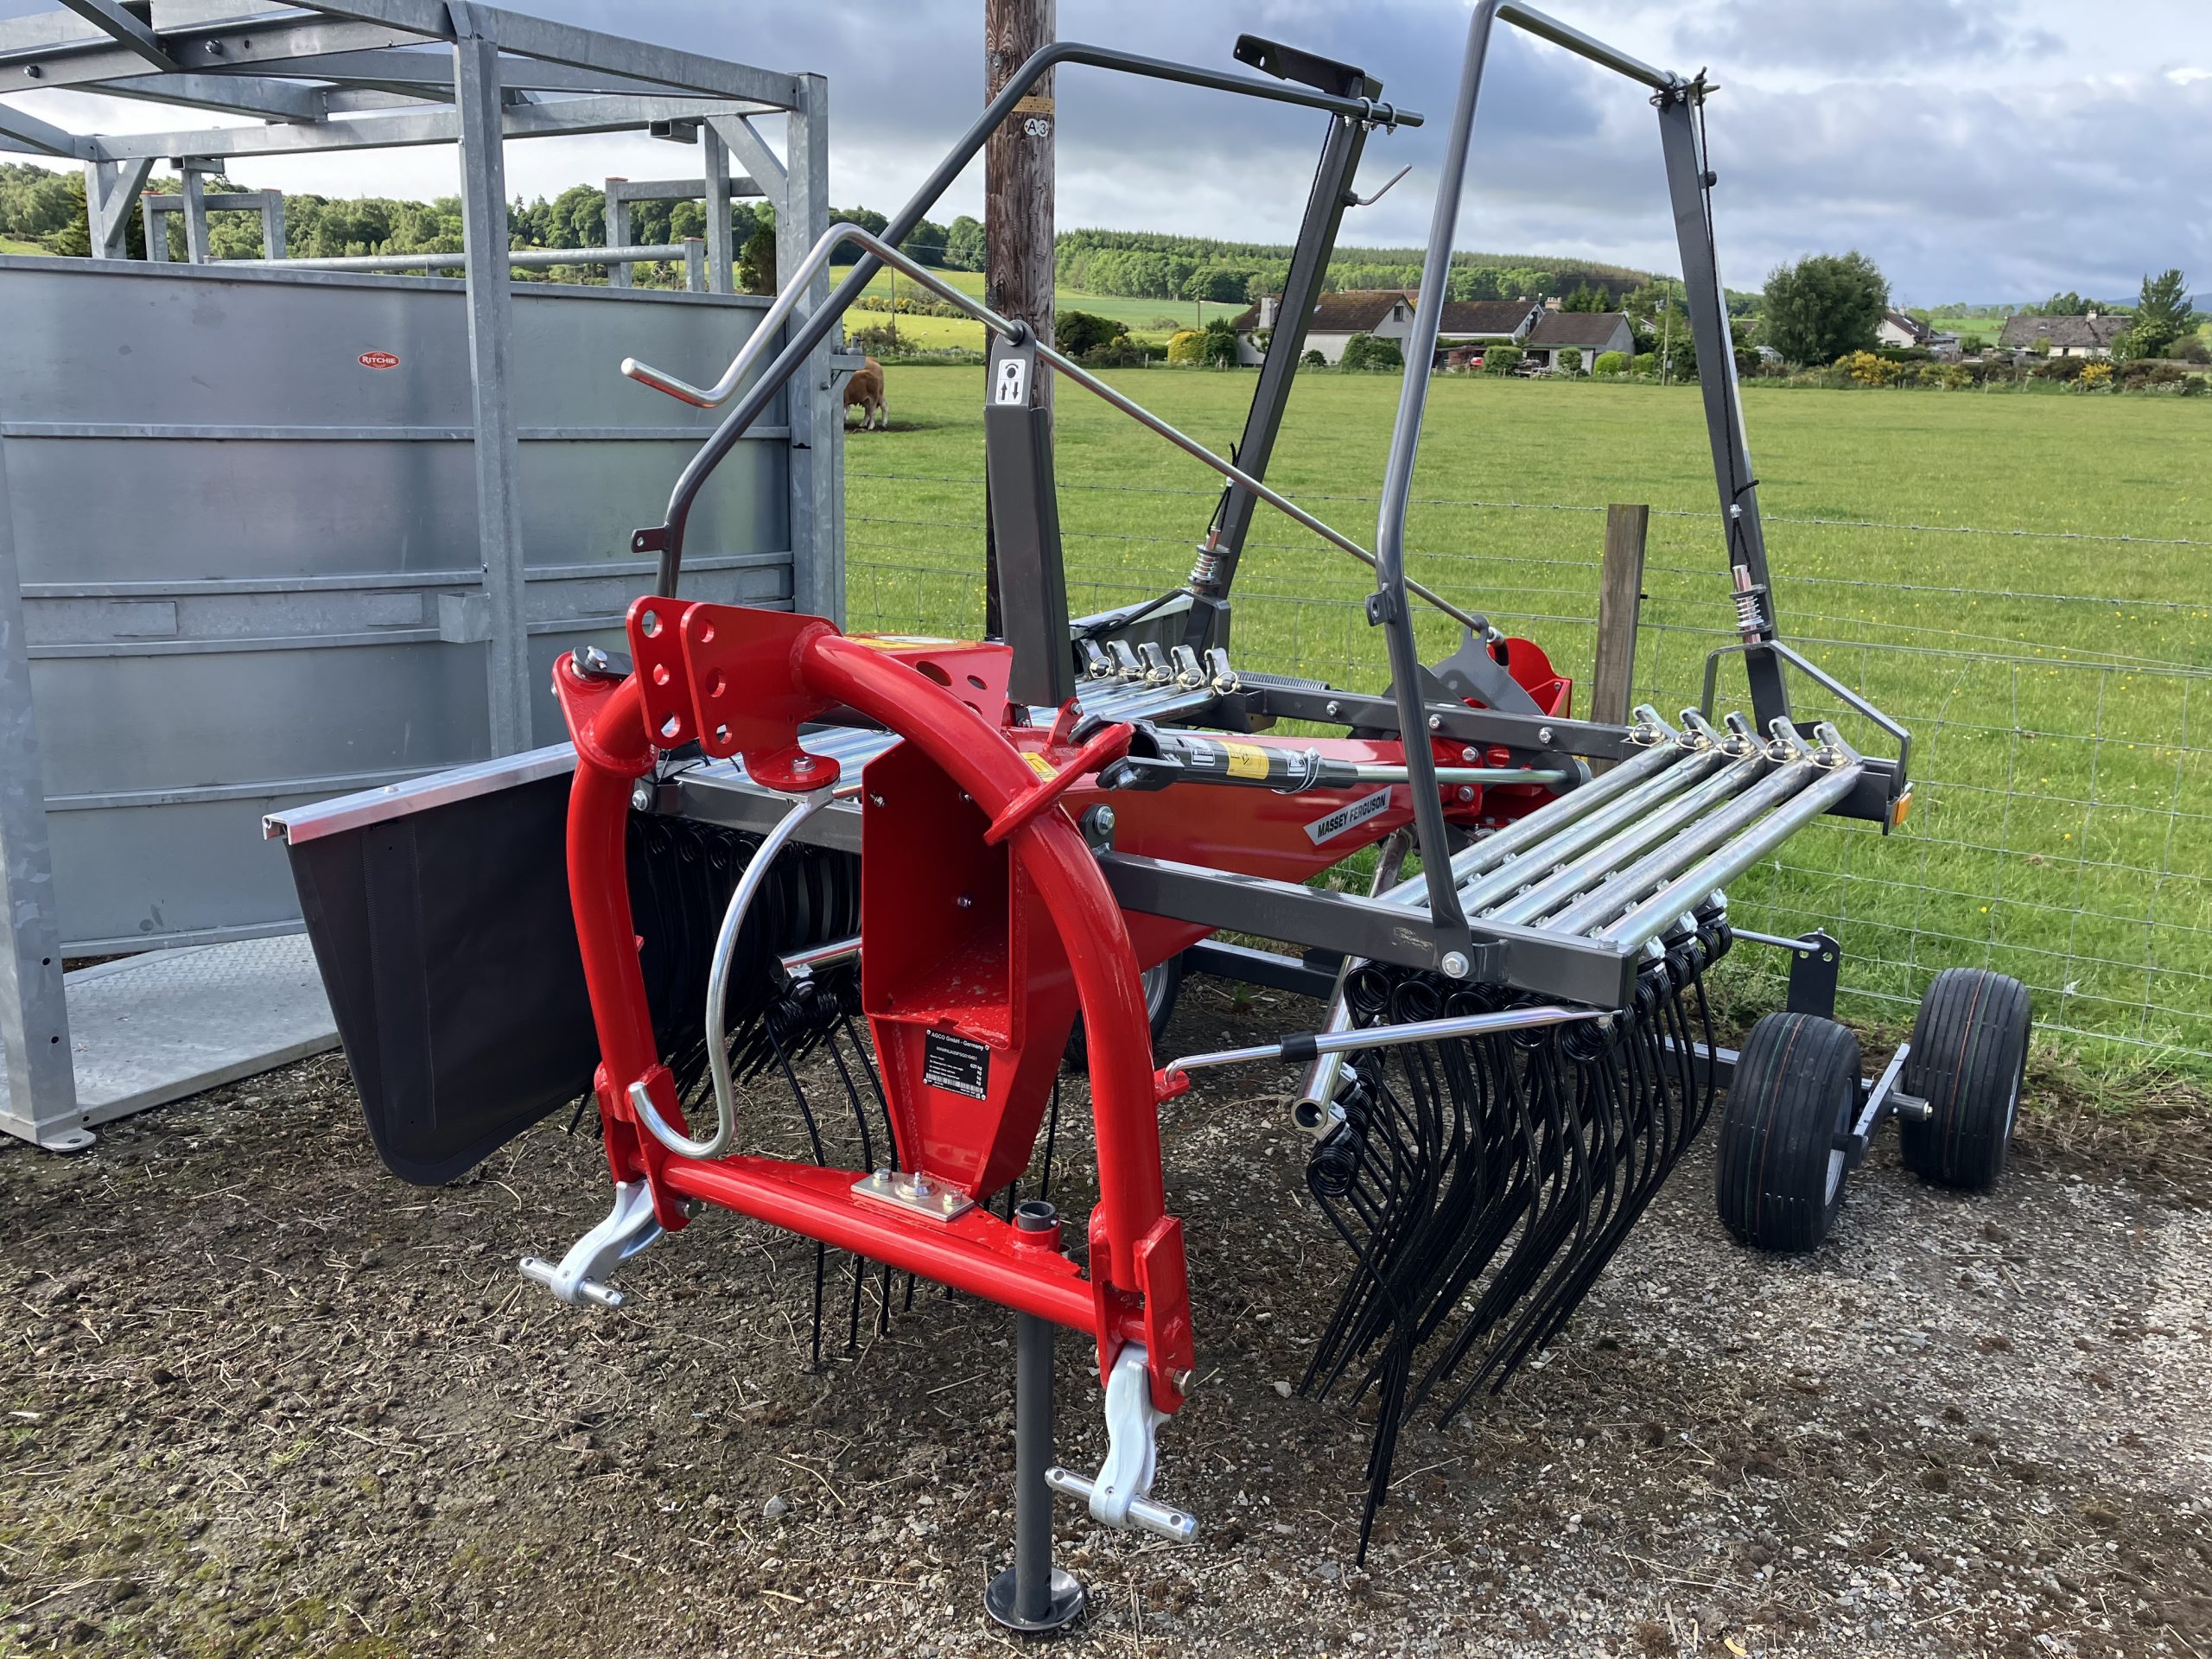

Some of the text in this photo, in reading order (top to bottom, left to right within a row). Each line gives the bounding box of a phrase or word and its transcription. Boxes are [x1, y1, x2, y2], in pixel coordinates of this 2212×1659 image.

[362, 355, 396, 364] RITCHIE
[1317, 793, 1386, 838] MASSEY FERGUSON
[931, 1032, 945, 1040] AGCO
[945, 1035, 960, 1044] GmbH
[963, 1039, 984, 1051] Germany
